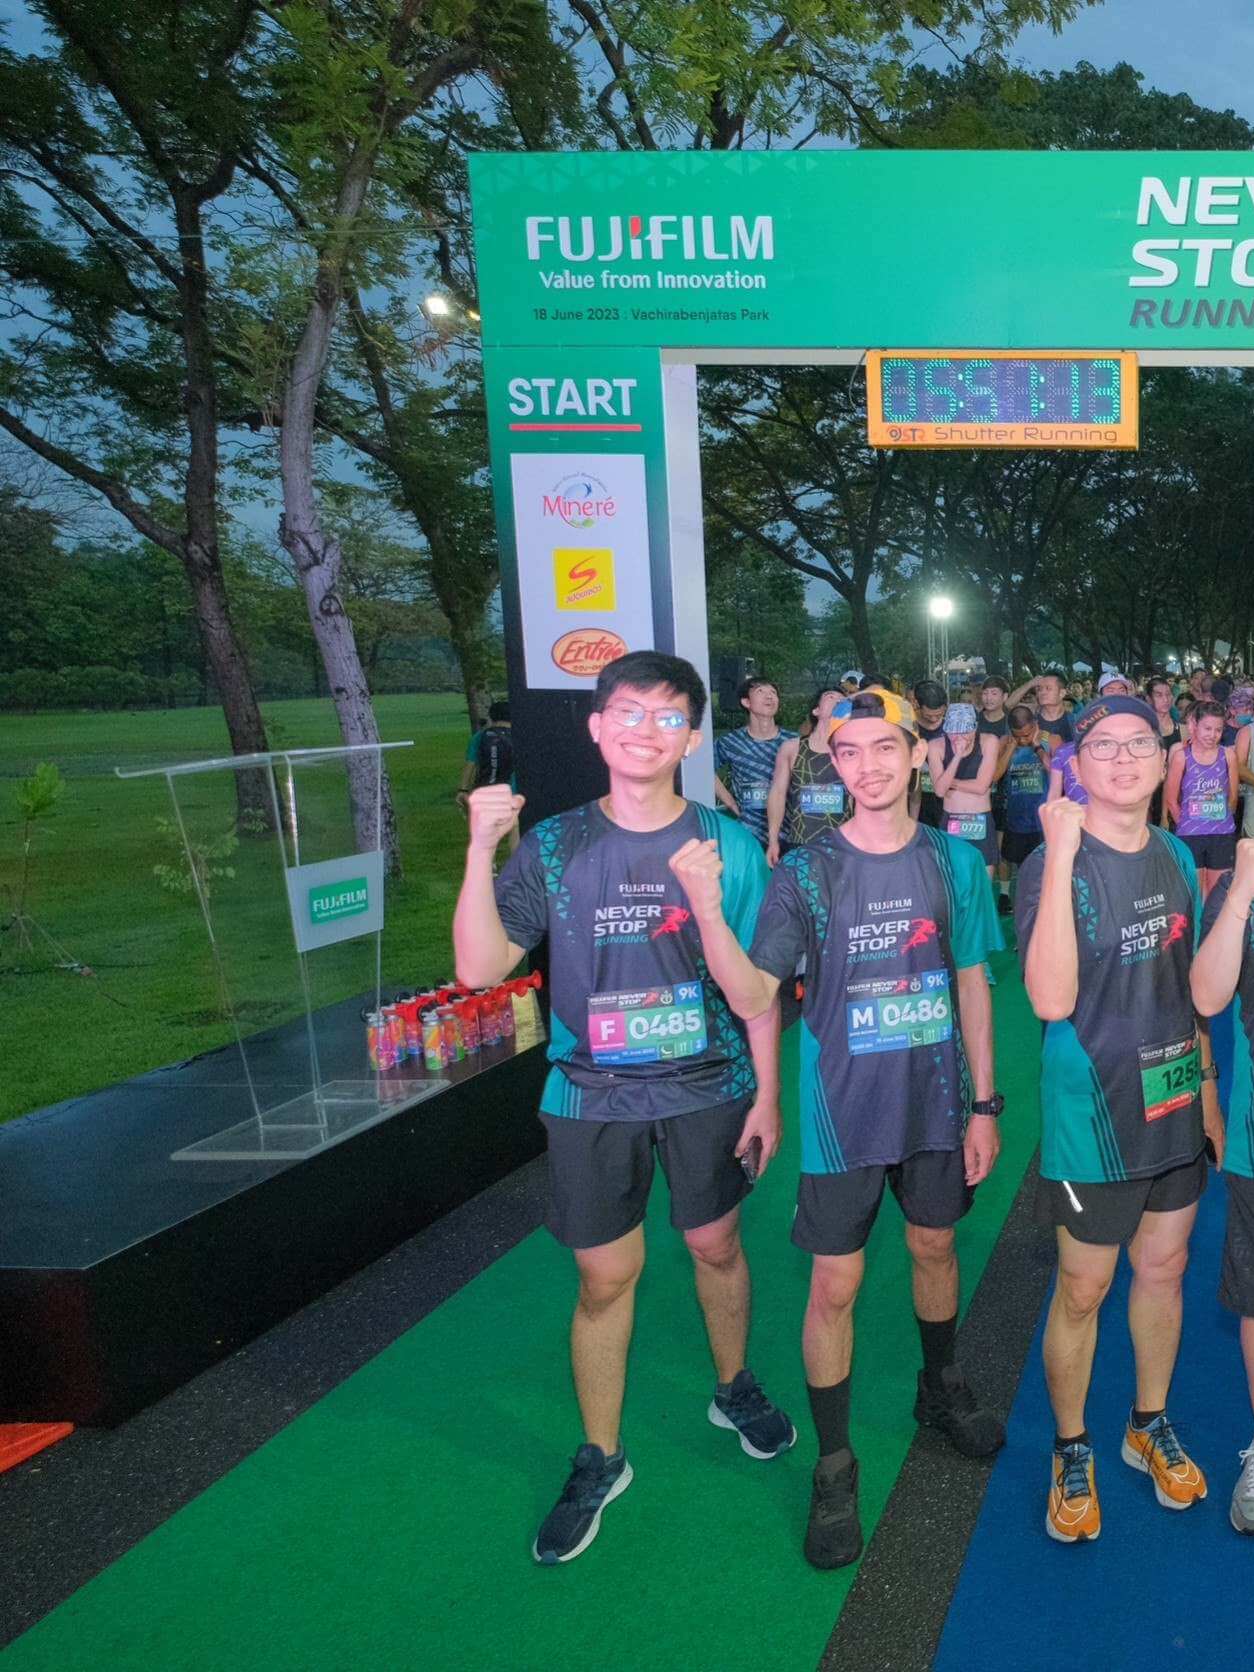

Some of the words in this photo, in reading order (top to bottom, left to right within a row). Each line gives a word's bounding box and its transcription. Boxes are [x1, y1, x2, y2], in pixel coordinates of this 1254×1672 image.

[525, 215, 774, 261] FUJIFILM
[540, 269, 595, 289] Value
[600, 269, 651, 289] from
[657, 269, 767, 289] Innovation
[532, 308, 547, 321] 18
[551, 308, 583, 321] June
[587, 308, 620, 321] 2023
[631, 308, 737, 324] Vachirabenjatas
[741, 308, 769, 321] Park
[508, 378, 637, 416] START
[935, 428, 1016, 441] Shutter
[1024, 428, 1117, 443] Running
[802, 794, 811, 803] M
[595, 904, 662, 921] NEVER
[868, 899, 912, 911] FUJIFILM
[594, 920, 648, 937] STOP
[849, 920, 910, 939] NEVER
[1121, 916, 1168, 940] NEVER
[847, 936, 897, 954] STOP
[1120, 933, 1159, 956] STOP
[847, 950, 898, 964] RUNNING
[927, 973, 945, 988] 9K
[678, 986, 698, 1000] 9K
[851, 1006, 874, 1029] M
[882, 997, 948, 1027] 0486
[601, 1020, 615, 1041] F
[630, 1009, 702, 1040] 0485
